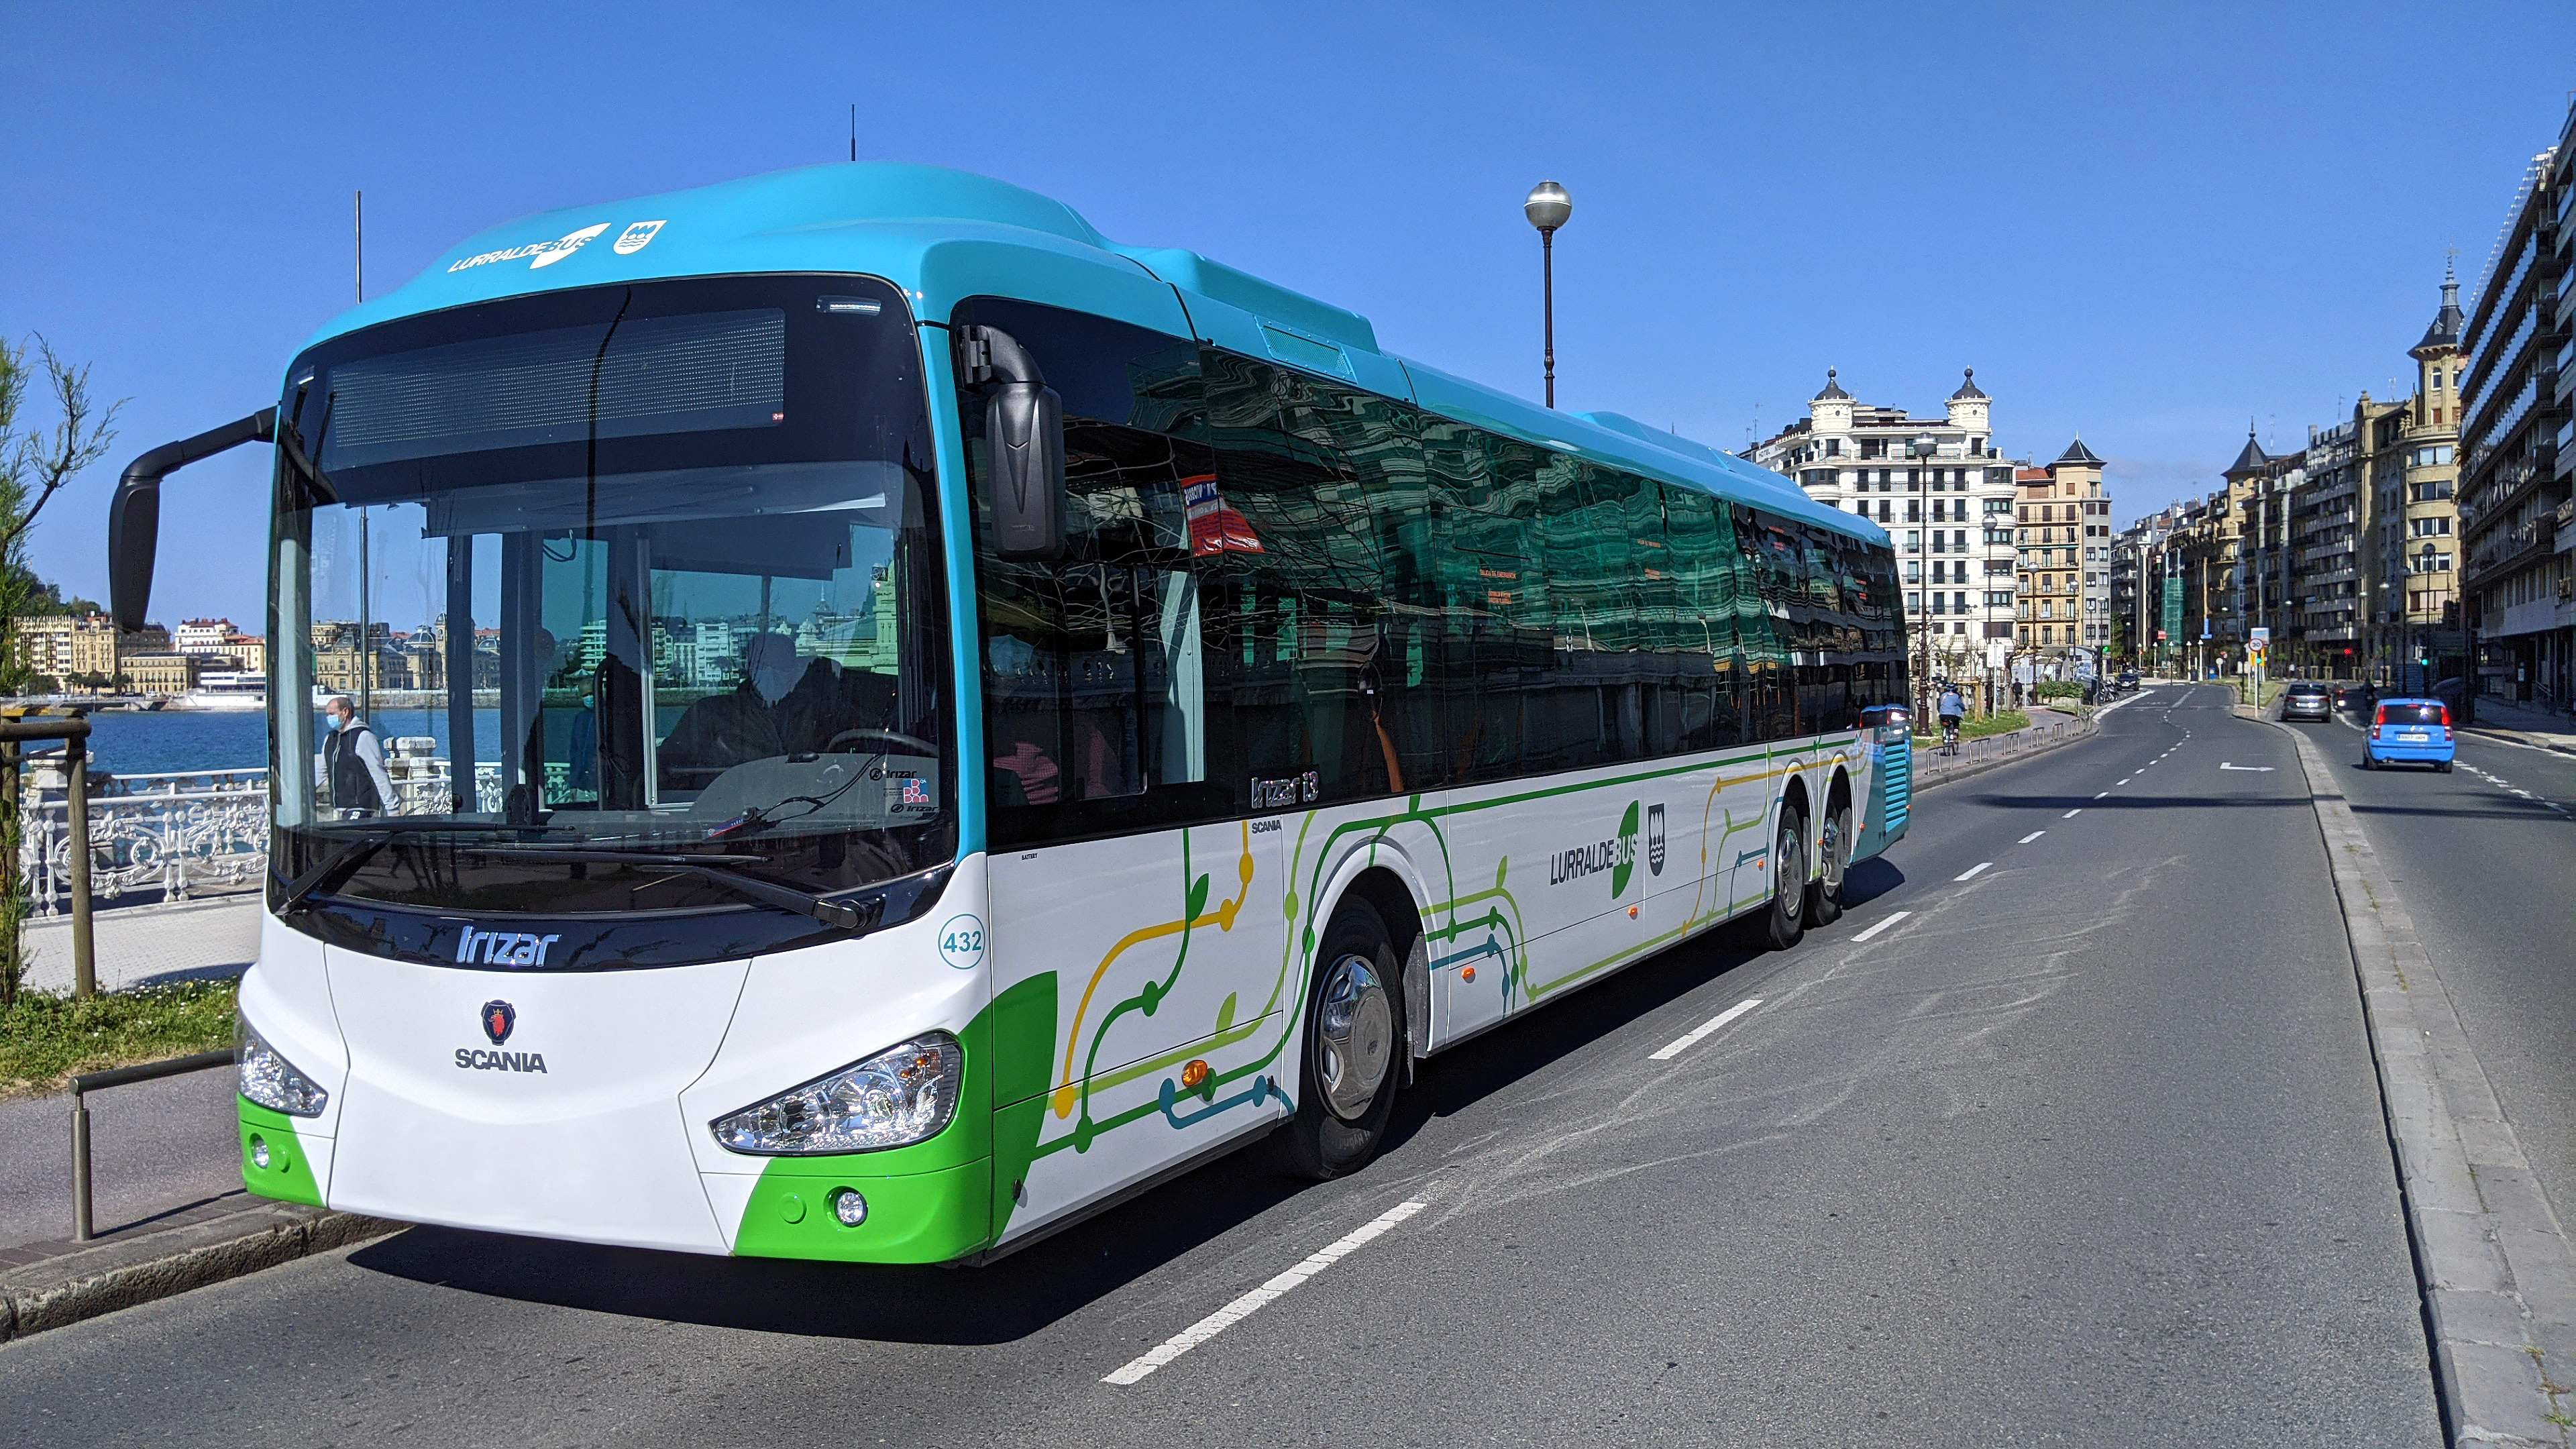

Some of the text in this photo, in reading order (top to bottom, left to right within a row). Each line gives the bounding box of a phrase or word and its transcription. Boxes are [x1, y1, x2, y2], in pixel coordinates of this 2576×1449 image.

[447, 235, 595, 273] LURRALDEBUS
[886, 770, 917, 779] Irizar
[1302, 771, 1319, 802] i3
[1252, 820, 1282, 834] SCANIA
[1550, 833, 1638, 886] LURRALDEBUS
[455, 924, 561, 967] Irizar
[943, 930, 982, 953] 432
[454, 1048, 548, 1074] SCANIA
